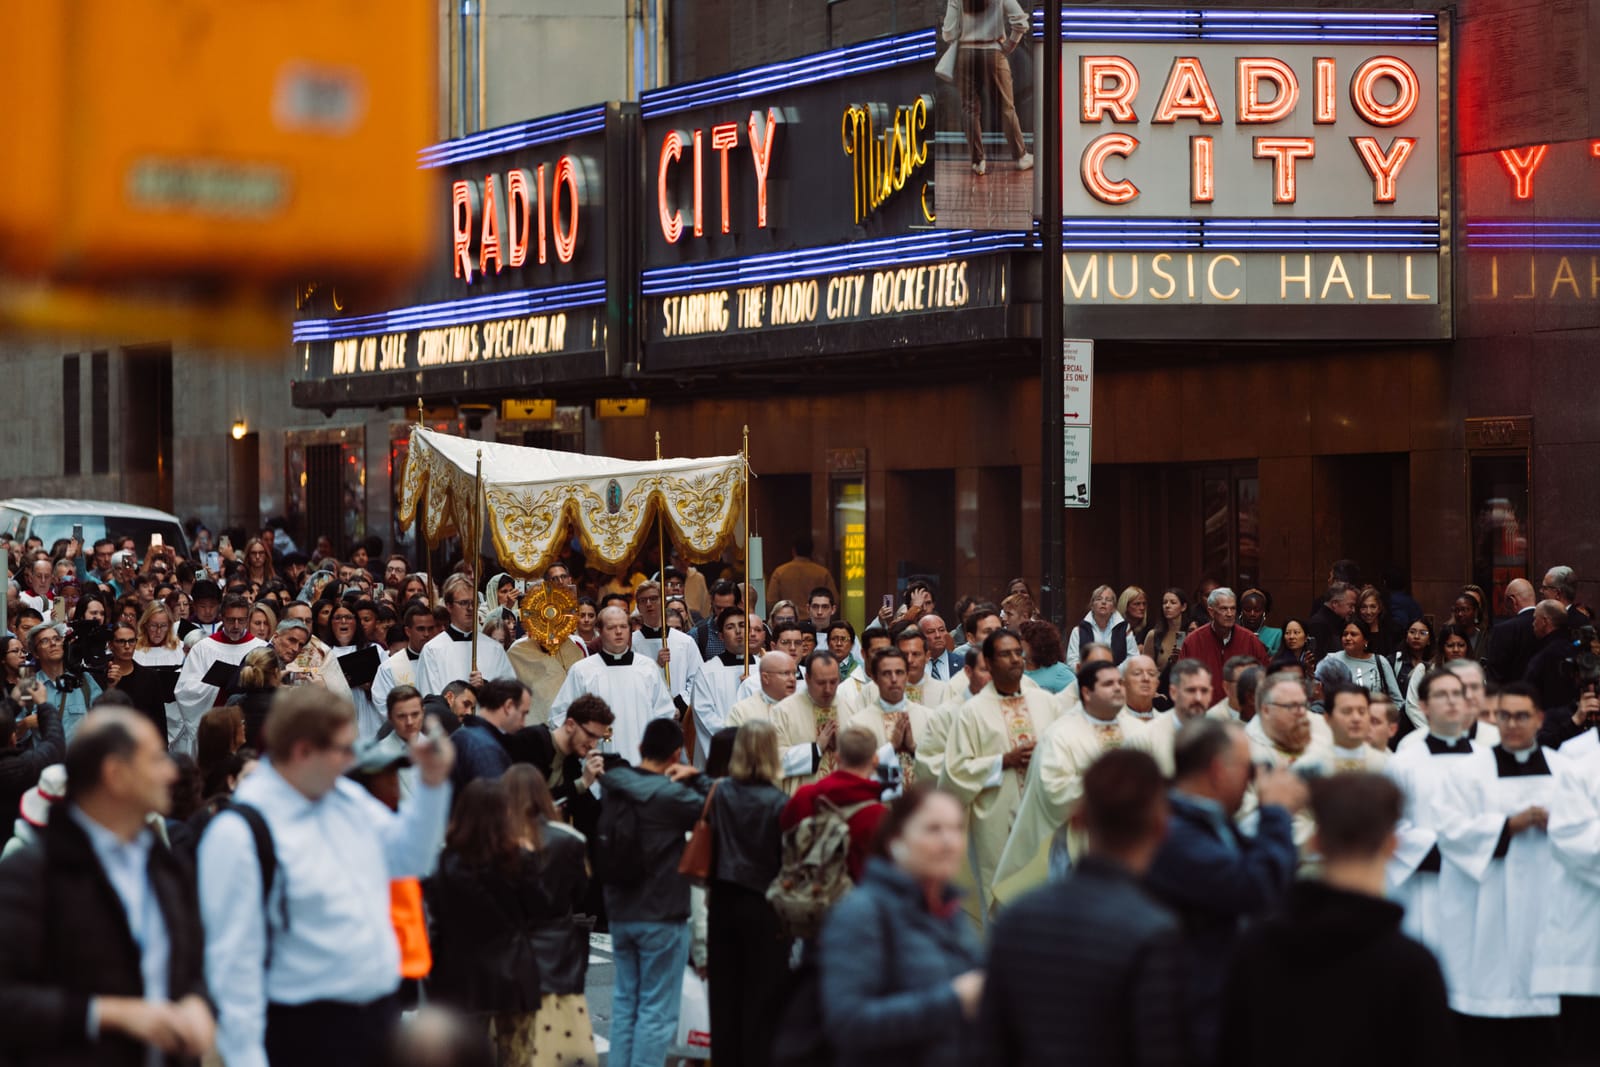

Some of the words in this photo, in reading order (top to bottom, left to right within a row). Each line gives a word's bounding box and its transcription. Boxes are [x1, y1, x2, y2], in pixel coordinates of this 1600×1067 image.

[1079, 55, 1420, 127] RADIO
[658, 107, 778, 244] CITY
[1081, 132, 1419, 204] CITY
[453, 155, 580, 283] RADIO
[662, 292, 729, 338] STARRING
[736, 286, 766, 329] THE
[771, 279, 819, 326] RADIO
[826, 275, 865, 320] CITY
[871, 262, 969, 314] ROCKETTES
[1062, 253, 1242, 303] MUSIC
[1279, 254, 1432, 302] HALL
[332, 339, 358, 375] NOW
[360, 337, 378, 372] ON
[379, 333, 408, 370] SALE
[417, 325, 480, 365] CHRISTMAS
[481, 314, 566, 359] SPECTACULAR
